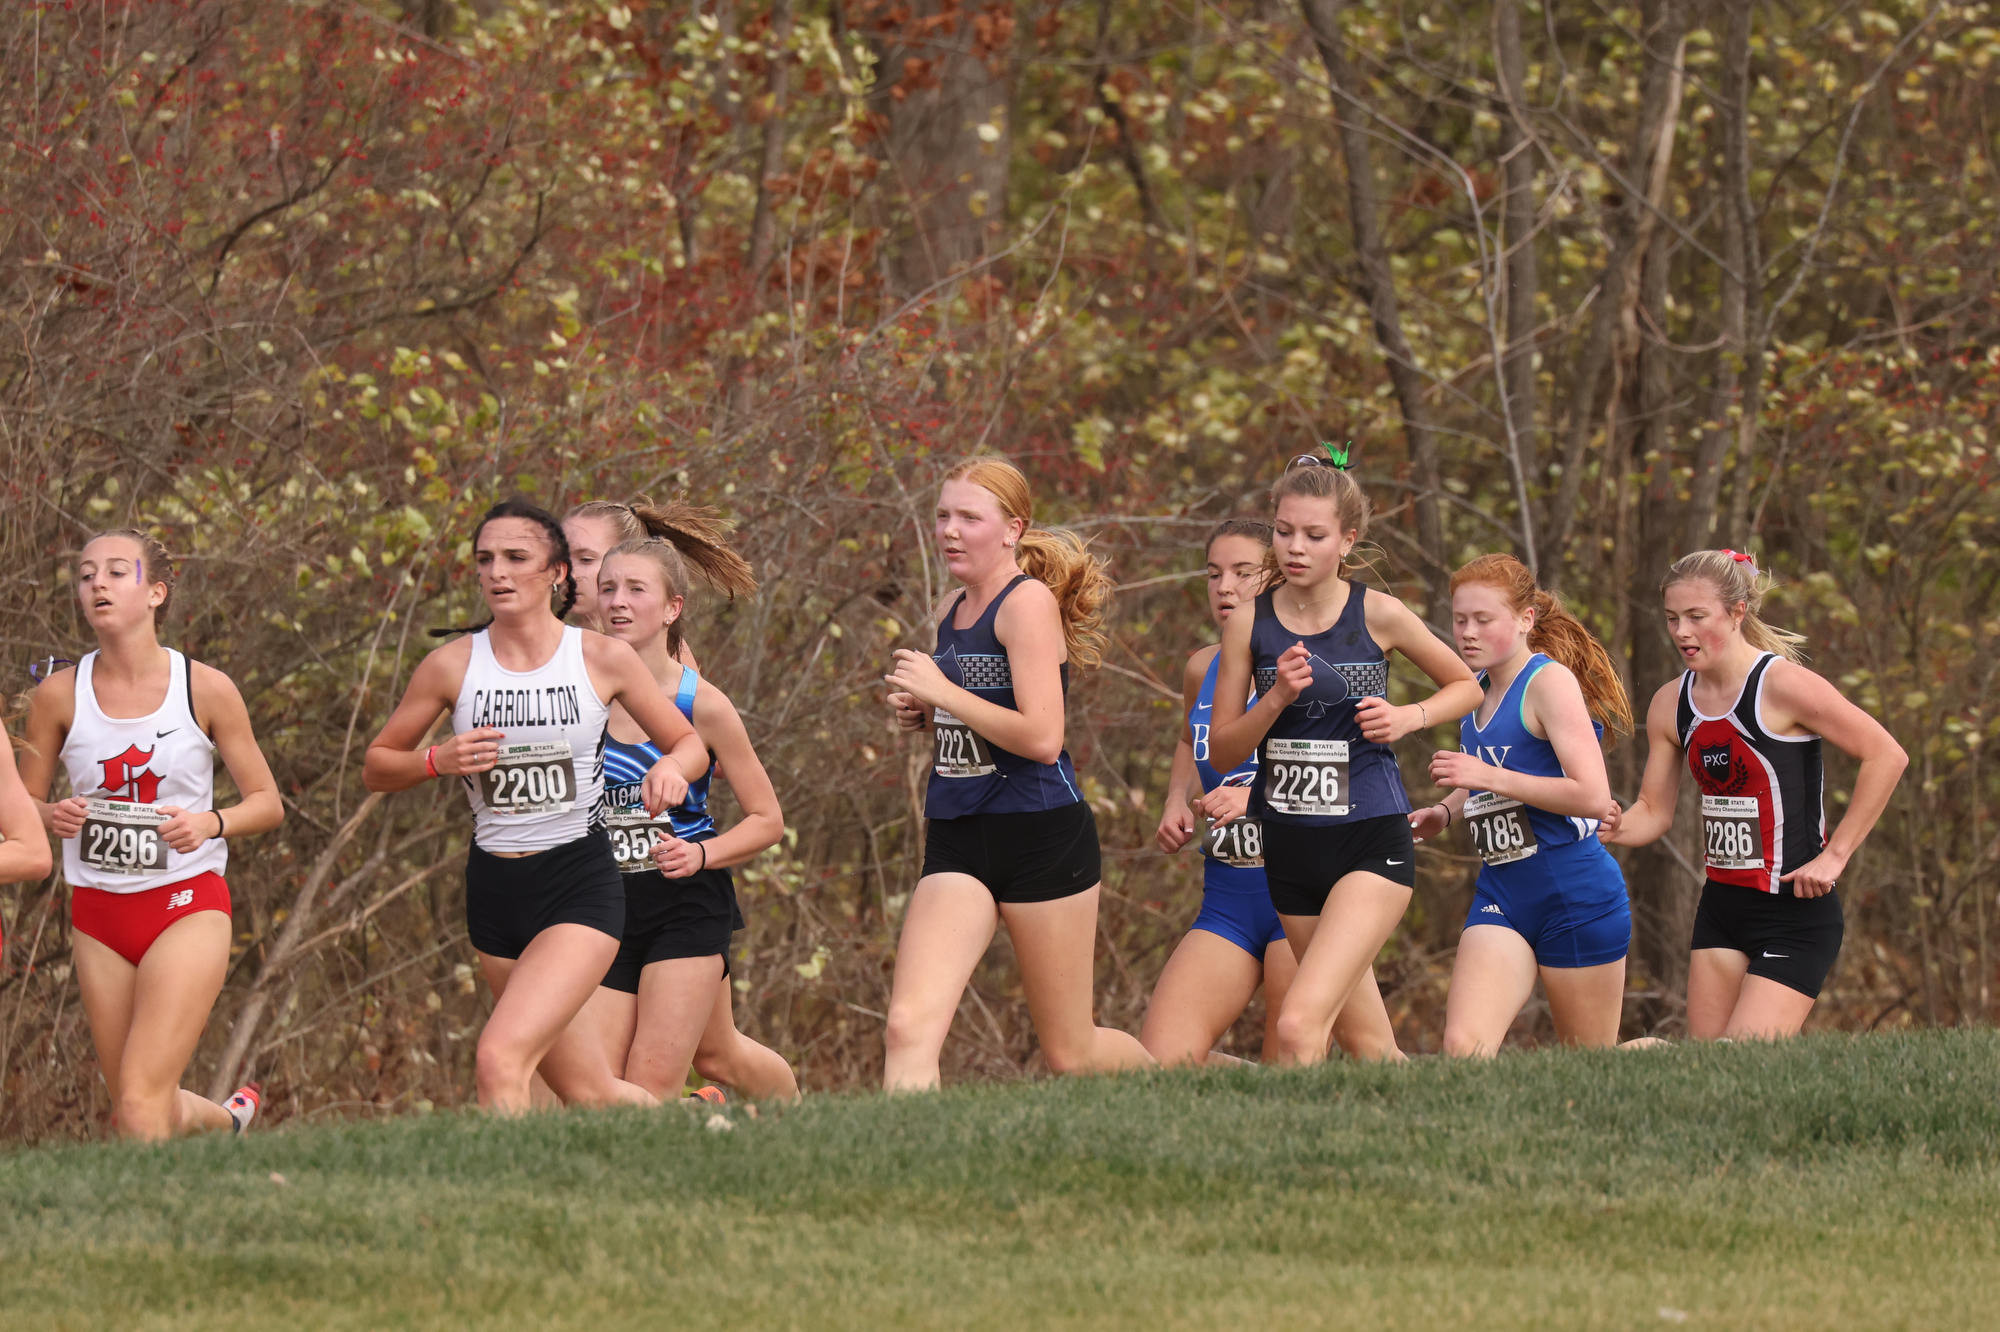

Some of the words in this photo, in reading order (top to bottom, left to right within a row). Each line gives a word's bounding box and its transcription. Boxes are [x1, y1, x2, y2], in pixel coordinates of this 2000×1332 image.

[472, 685, 580, 728] CARROLLTON
[522, 750, 569, 758] Championships
[937, 728, 981, 764] 2221
[1703, 753, 1728, 768] PXC
[490, 764, 567, 804] 2200
[1272, 764, 1338, 802] 2226
[97, 809, 118, 818] Country
[120, 812, 168, 821] Championships
[1470, 812, 1524, 853] 2185
[88, 824, 158, 866] 2296
[1211, 822, 1263, 858] 218
[1706, 820, 1753, 856] 2286
